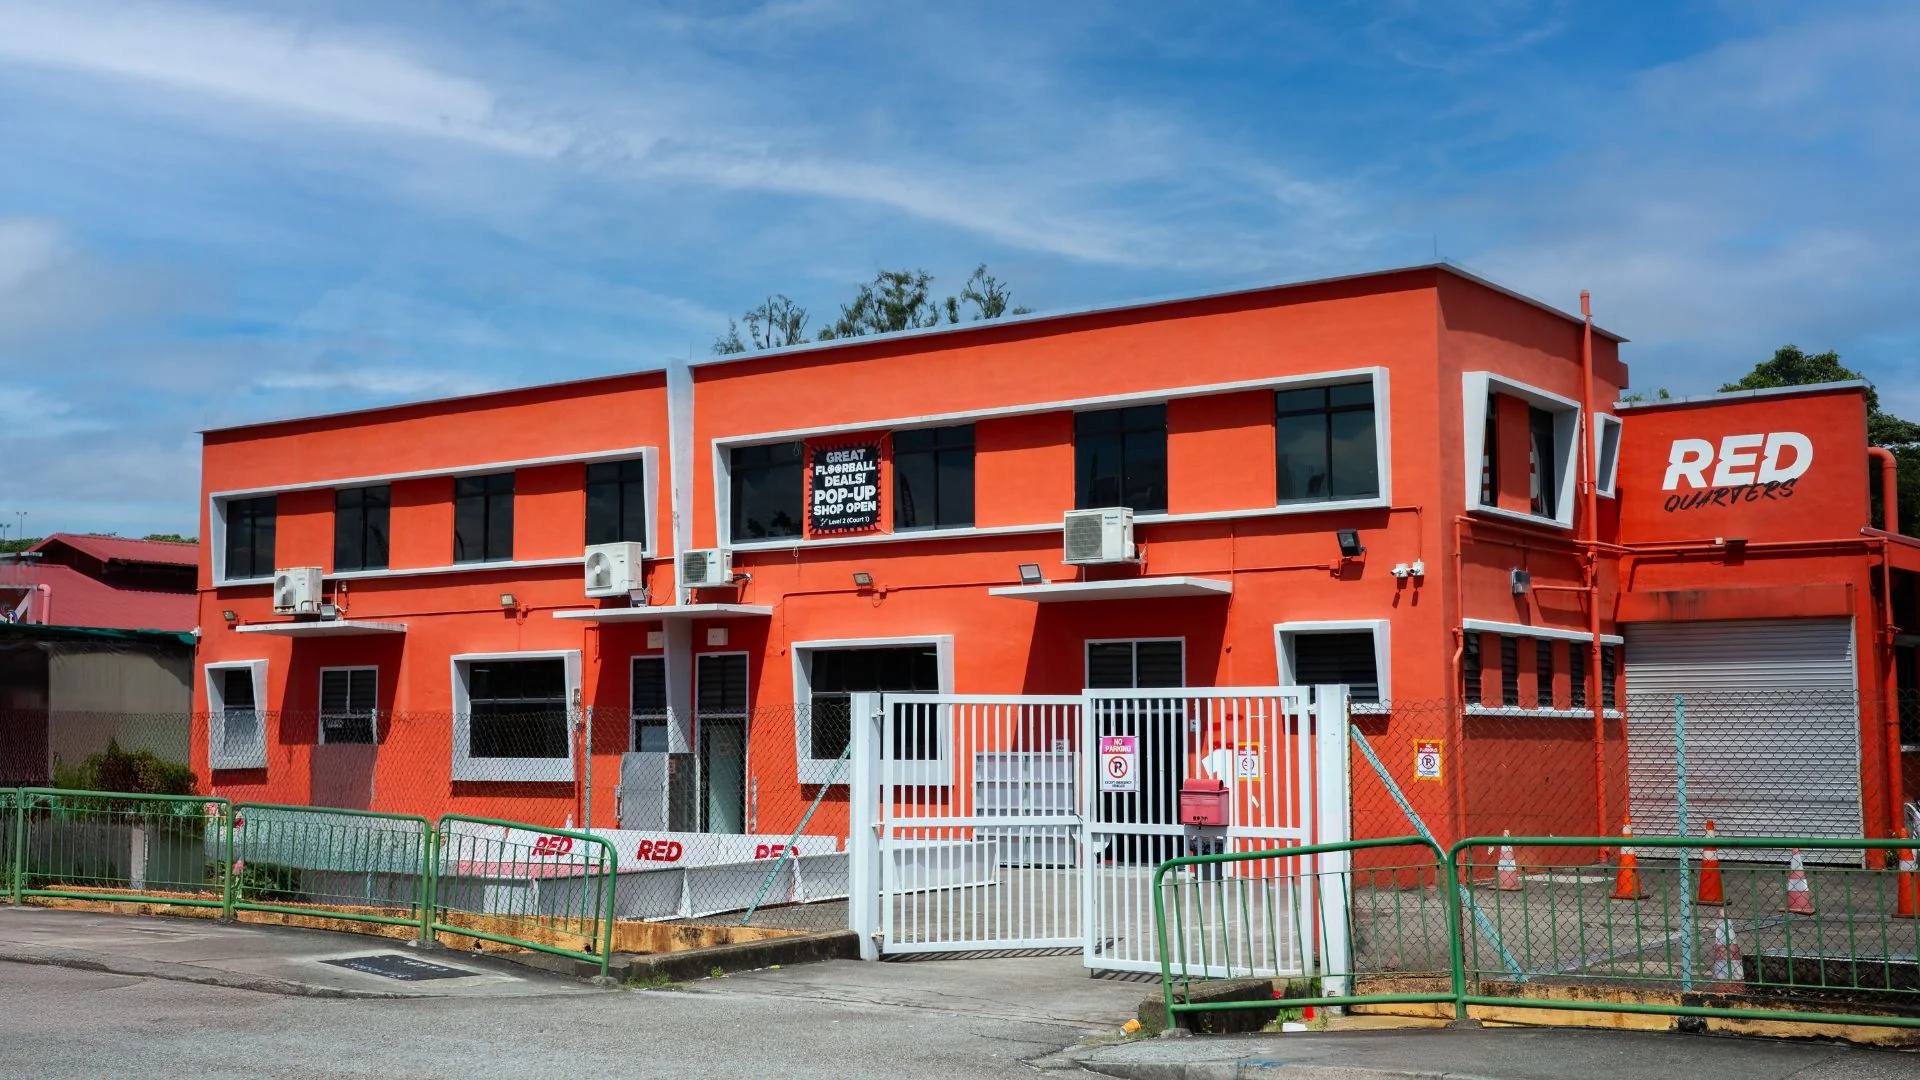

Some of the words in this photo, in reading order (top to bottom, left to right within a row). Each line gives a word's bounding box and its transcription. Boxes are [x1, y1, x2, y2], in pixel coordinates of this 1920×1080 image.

[826, 449, 865, 463] GREAT
[1662, 431, 1813, 490] RED
[815, 461, 875, 475] FLOORBALL
[825, 473, 866, 487] DEALS!
[814, 485, 876, 504] POP-UP
[1664, 478, 1798, 512] QUARTERS
[813, 504, 844, 515] SHOP
[846, 501, 876, 513] OPEN
[531, 836, 573, 856] RED
[636, 840, 682, 861] RED
